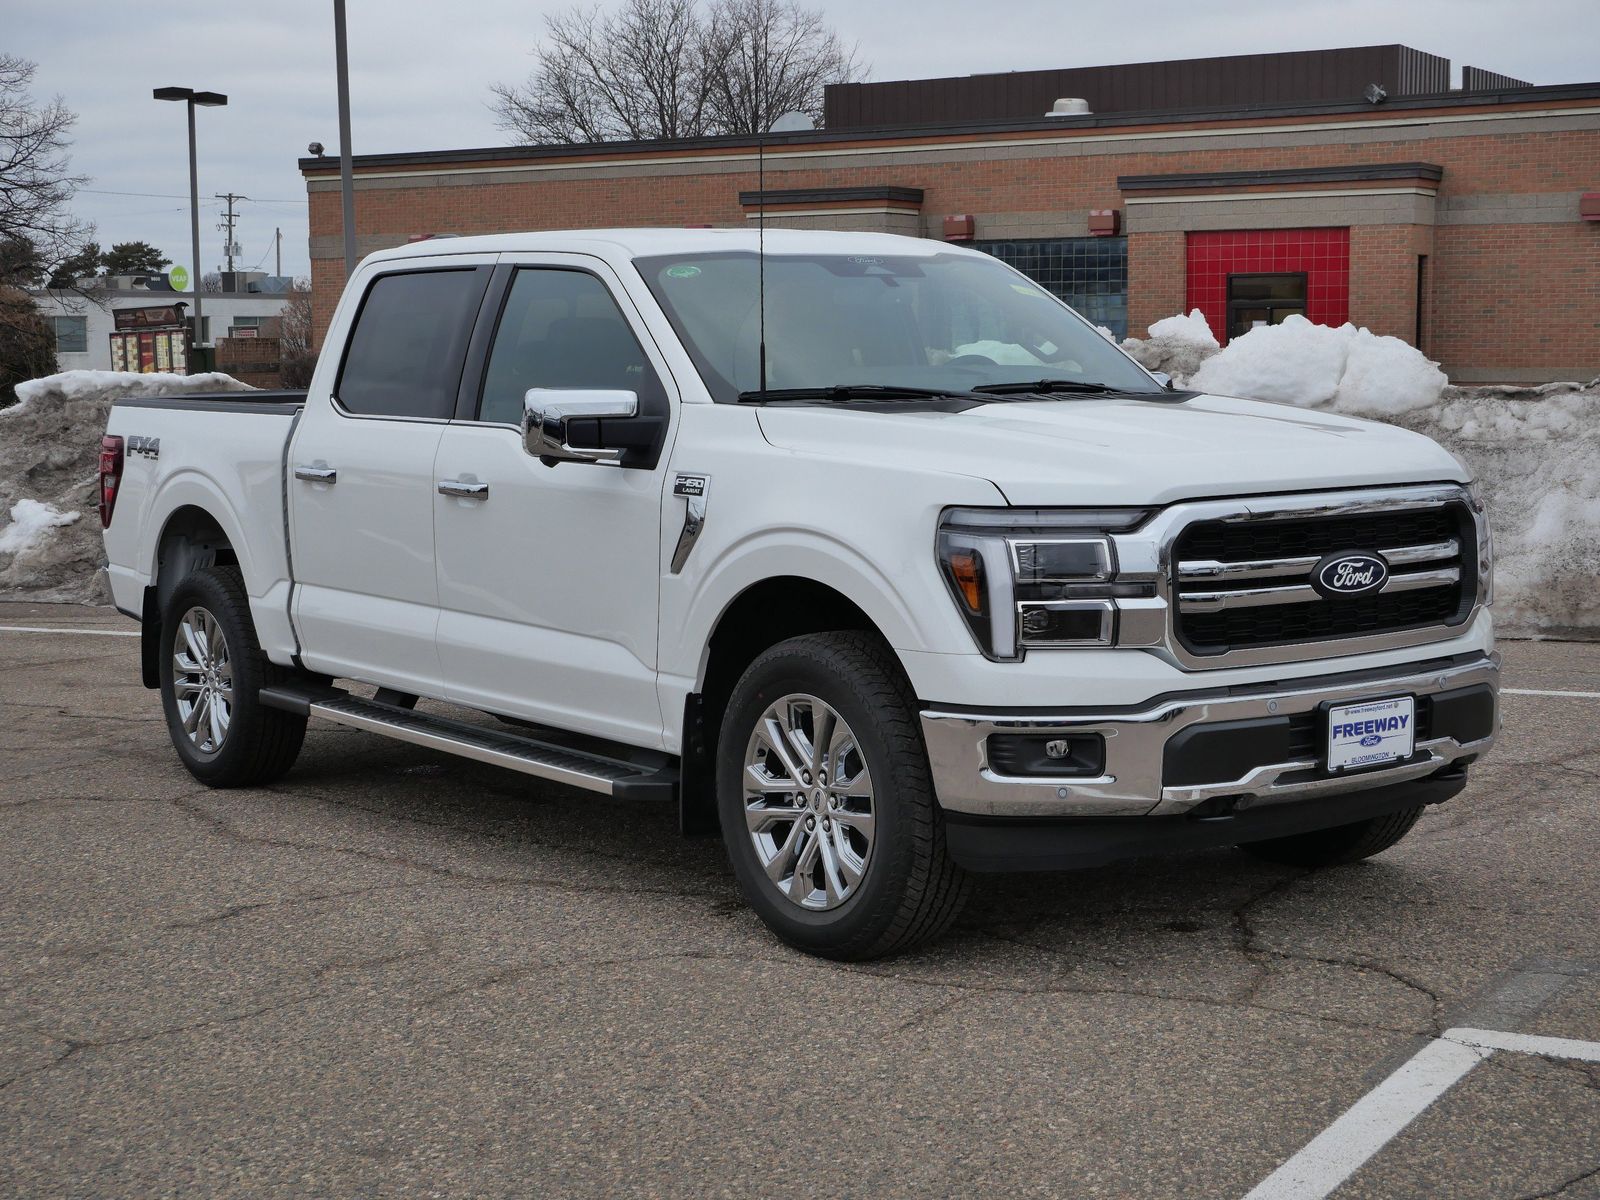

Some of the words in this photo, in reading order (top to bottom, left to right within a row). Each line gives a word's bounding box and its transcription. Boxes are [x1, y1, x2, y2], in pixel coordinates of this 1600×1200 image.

[127, 435, 160, 457] FX4
[1333, 561, 1374, 587] Ford
[1333, 714, 1409, 739] FREEWAY
[1351, 751, 1390, 763] BLOOMINGTON
